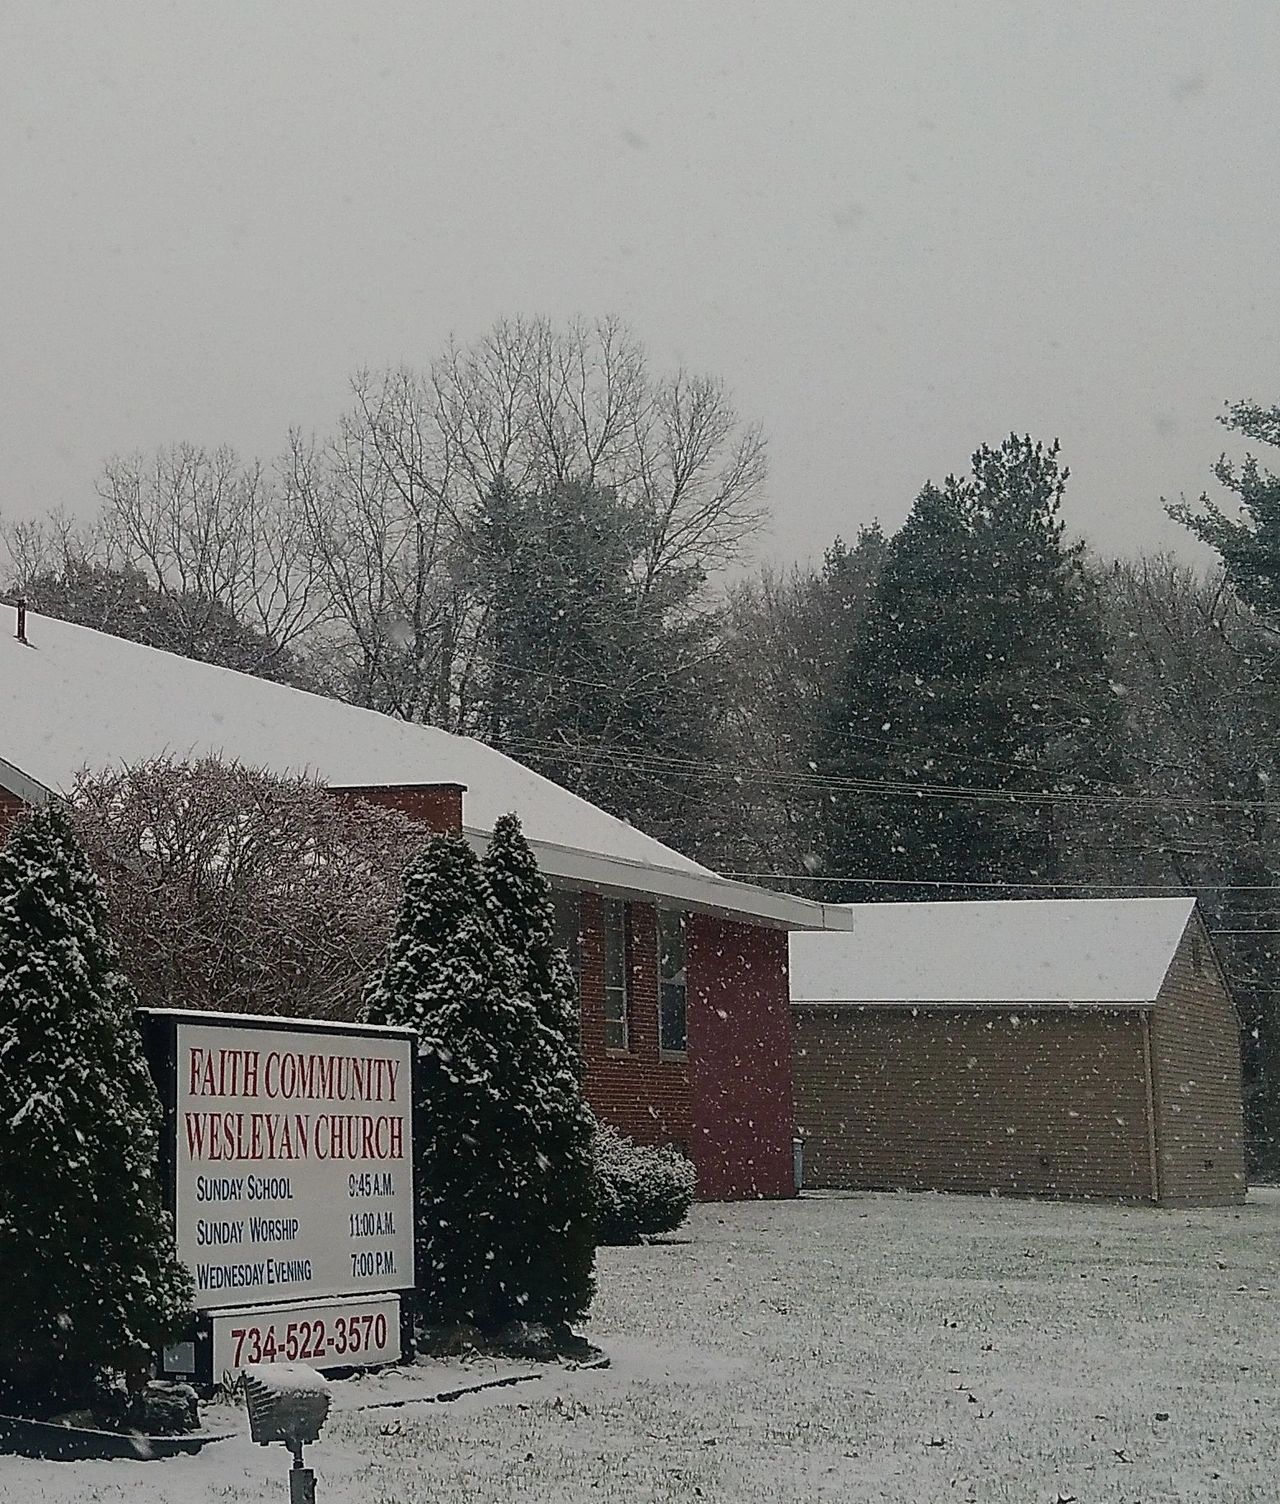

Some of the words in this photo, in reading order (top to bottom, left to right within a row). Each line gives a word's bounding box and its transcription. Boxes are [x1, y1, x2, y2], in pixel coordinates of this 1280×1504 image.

[189, 1048, 260, 1097] FAITH
[264, 1052, 400, 1102] COMMUNITY
[184, 1112, 309, 1161] WESLEYAN
[314, 1114, 404, 1160] CHURCH
[197, 1176, 243, 1202] SUNDAY
[248, 1174, 293, 1200] SCHOOL
[348, 1173, 371, 1198] 9:45
[373, 1173, 395, 1196] A.M.
[197, 1219, 243, 1246] SUNDAY
[250, 1216, 299, 1243] WORSHIP
[349, 1212, 374, 1237] 11:00
[376, 1212, 396, 1235] A.M.
[197, 1263, 264, 1290] WEDNESDAY
[267, 1258, 312, 1284] EVENING
[351, 1253, 374, 1278] 7:00
[376, 1251, 397, 1275] P.M.
[231, 1313, 387, 1368] 734-522-3570
